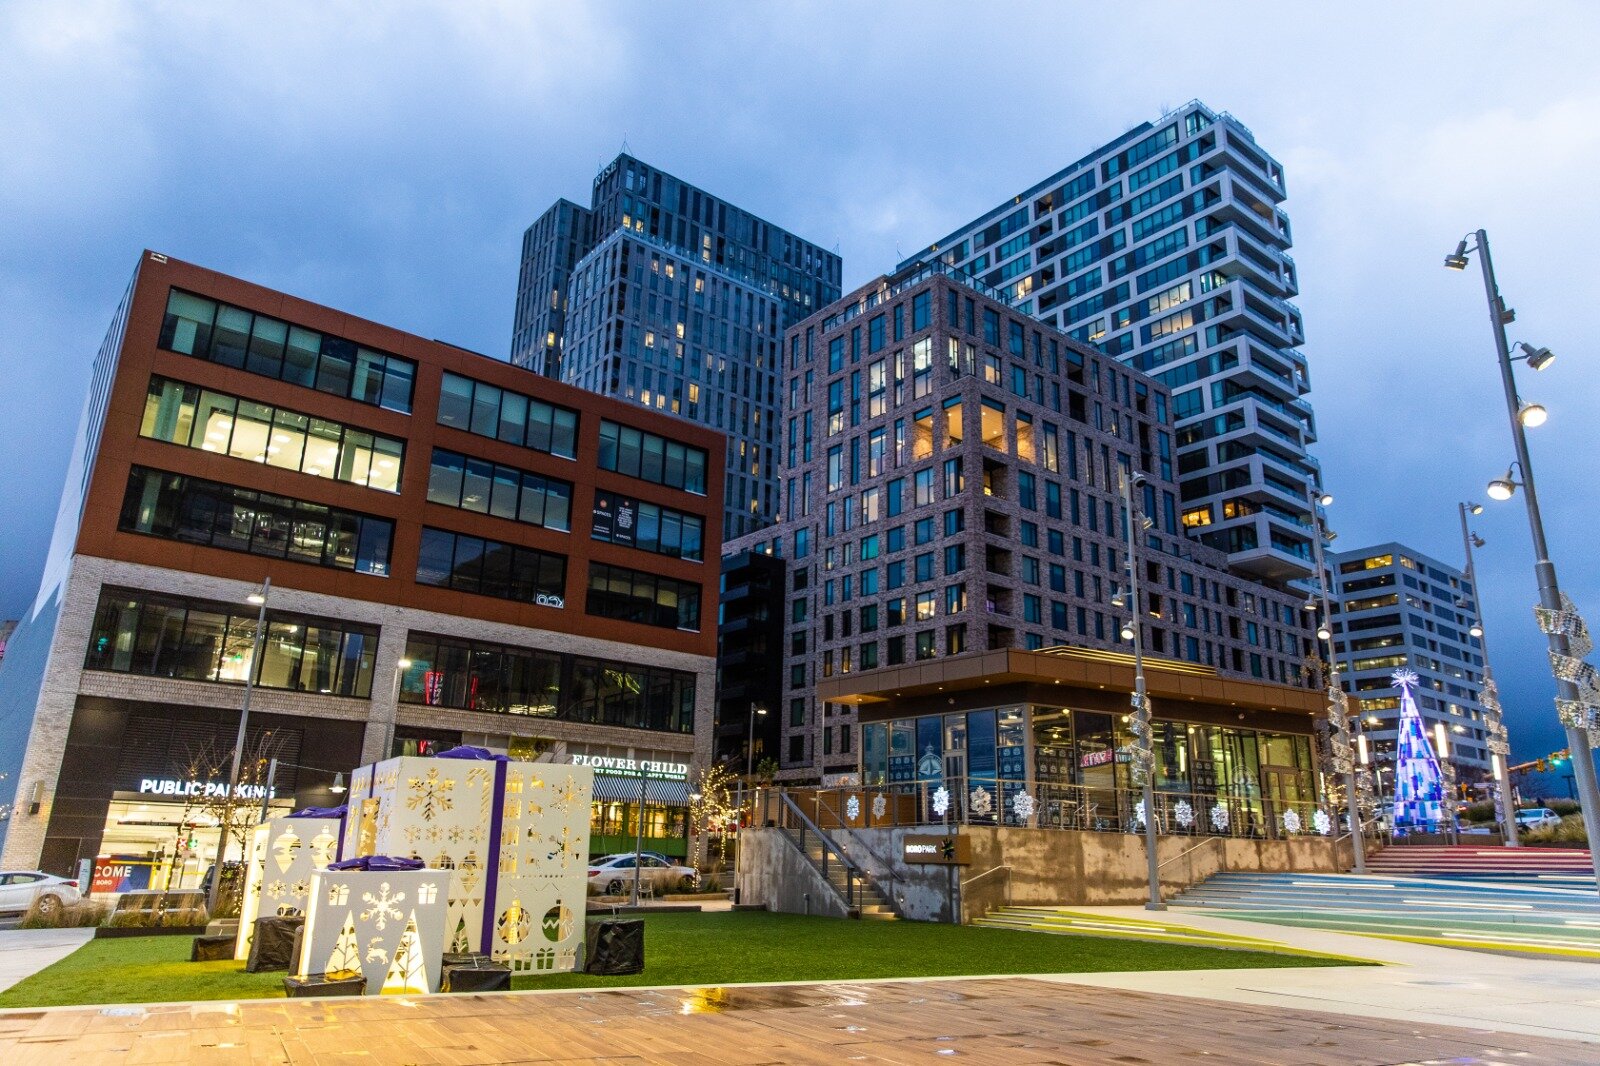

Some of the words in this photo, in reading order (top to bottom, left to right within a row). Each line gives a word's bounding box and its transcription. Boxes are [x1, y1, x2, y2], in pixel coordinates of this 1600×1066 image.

[572, 754, 637, 771] FLOWER
[640, 760, 688, 774] CHILD
[140, 779, 202, 796] PUBLIC
